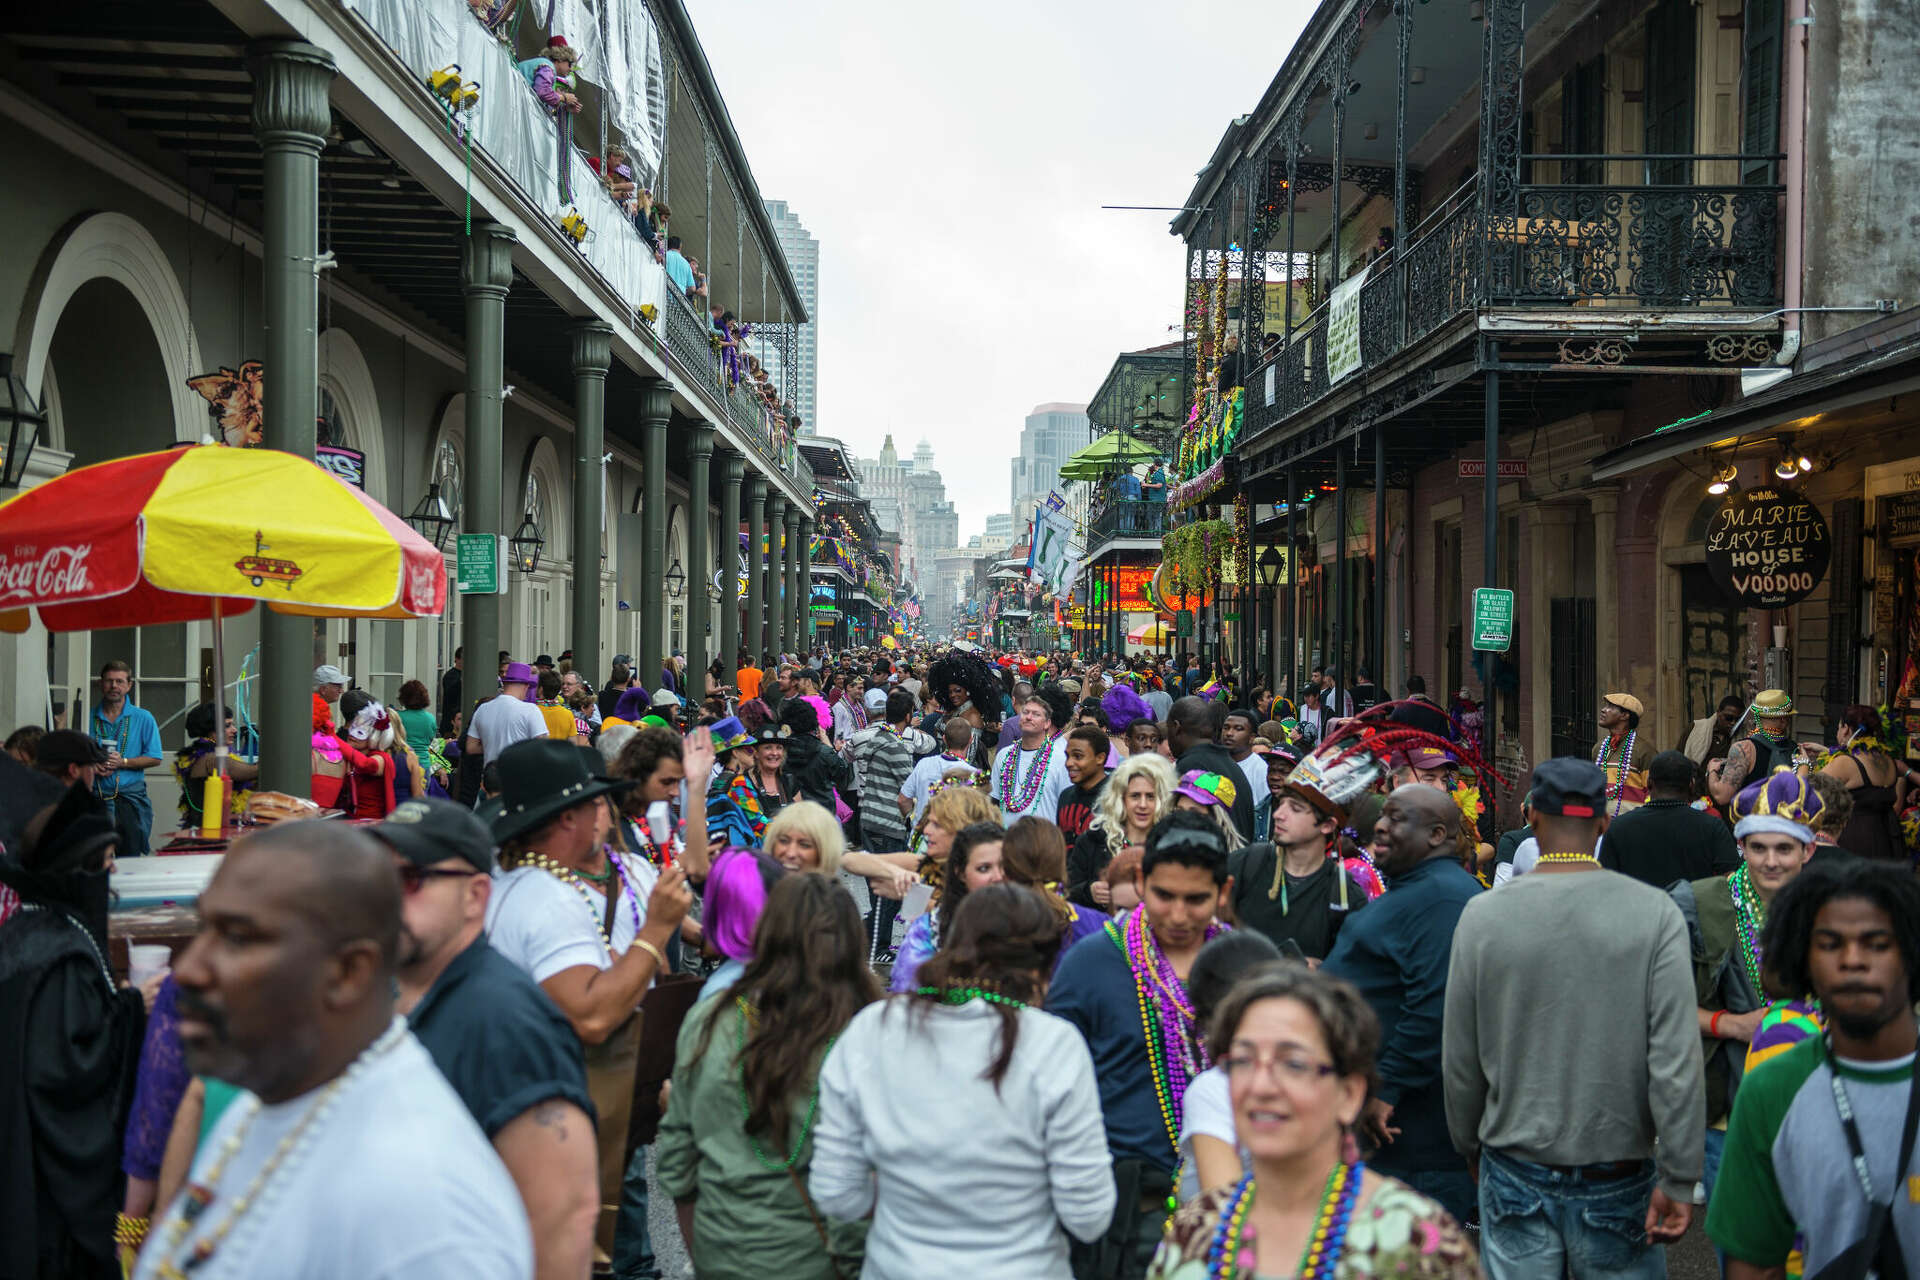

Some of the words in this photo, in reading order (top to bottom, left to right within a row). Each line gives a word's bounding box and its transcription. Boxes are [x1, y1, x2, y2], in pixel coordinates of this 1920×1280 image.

[1461, 462, 1526, 474] COMRCIAL
[1721, 504, 1811, 530] MARIE
[1708, 521, 1824, 552] LAVEAU'S
[1731, 547, 1804, 567] HOUSE
[1762, 562, 1780, 575] of
[0, 543, 92, 597] oca-Cola
[1732, 572, 1813, 595] VOODOO
